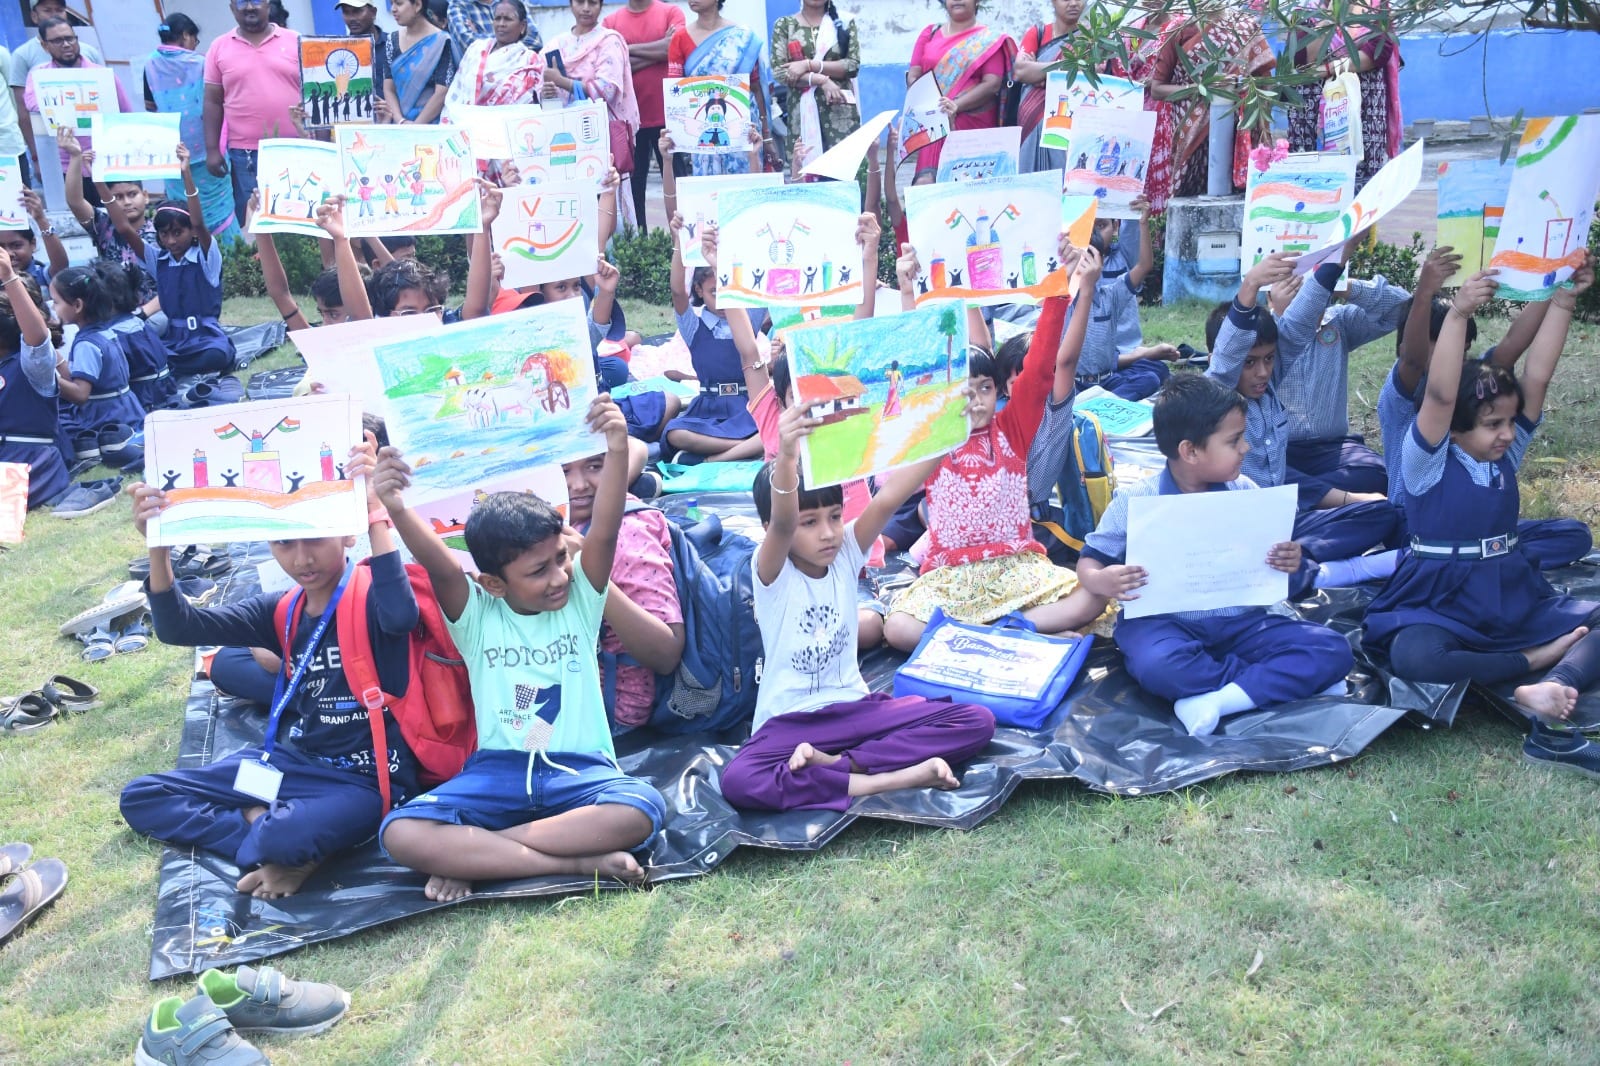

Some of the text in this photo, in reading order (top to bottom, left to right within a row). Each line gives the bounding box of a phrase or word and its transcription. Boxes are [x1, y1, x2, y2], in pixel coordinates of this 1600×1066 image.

[521, 196, 578, 219] VTE
[299, 639, 315, 666] SCHOOL
[320, 715, 350, 725] BRAND
